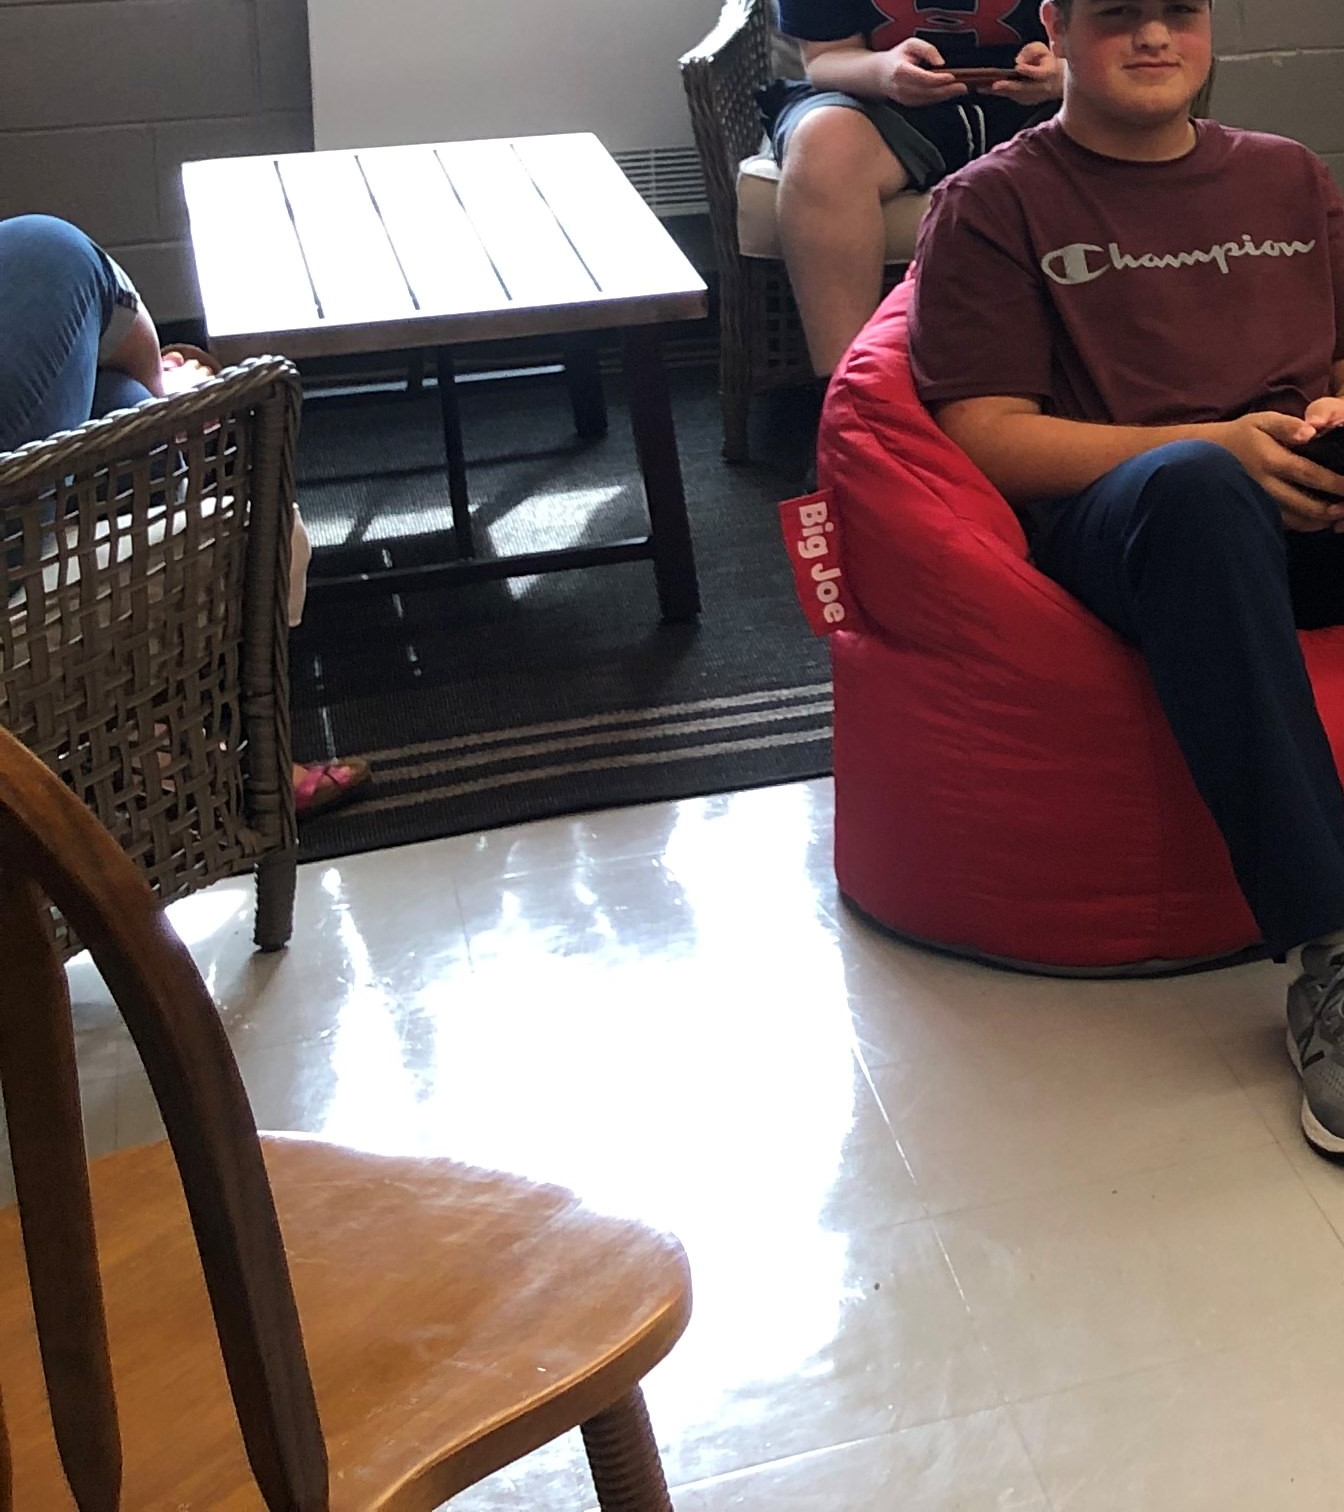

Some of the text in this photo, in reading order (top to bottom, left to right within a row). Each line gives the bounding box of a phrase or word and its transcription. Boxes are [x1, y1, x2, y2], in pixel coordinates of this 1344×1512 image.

[1041, 234, 1316, 285] Champion
[798, 502, 845, 623] Big Joe
